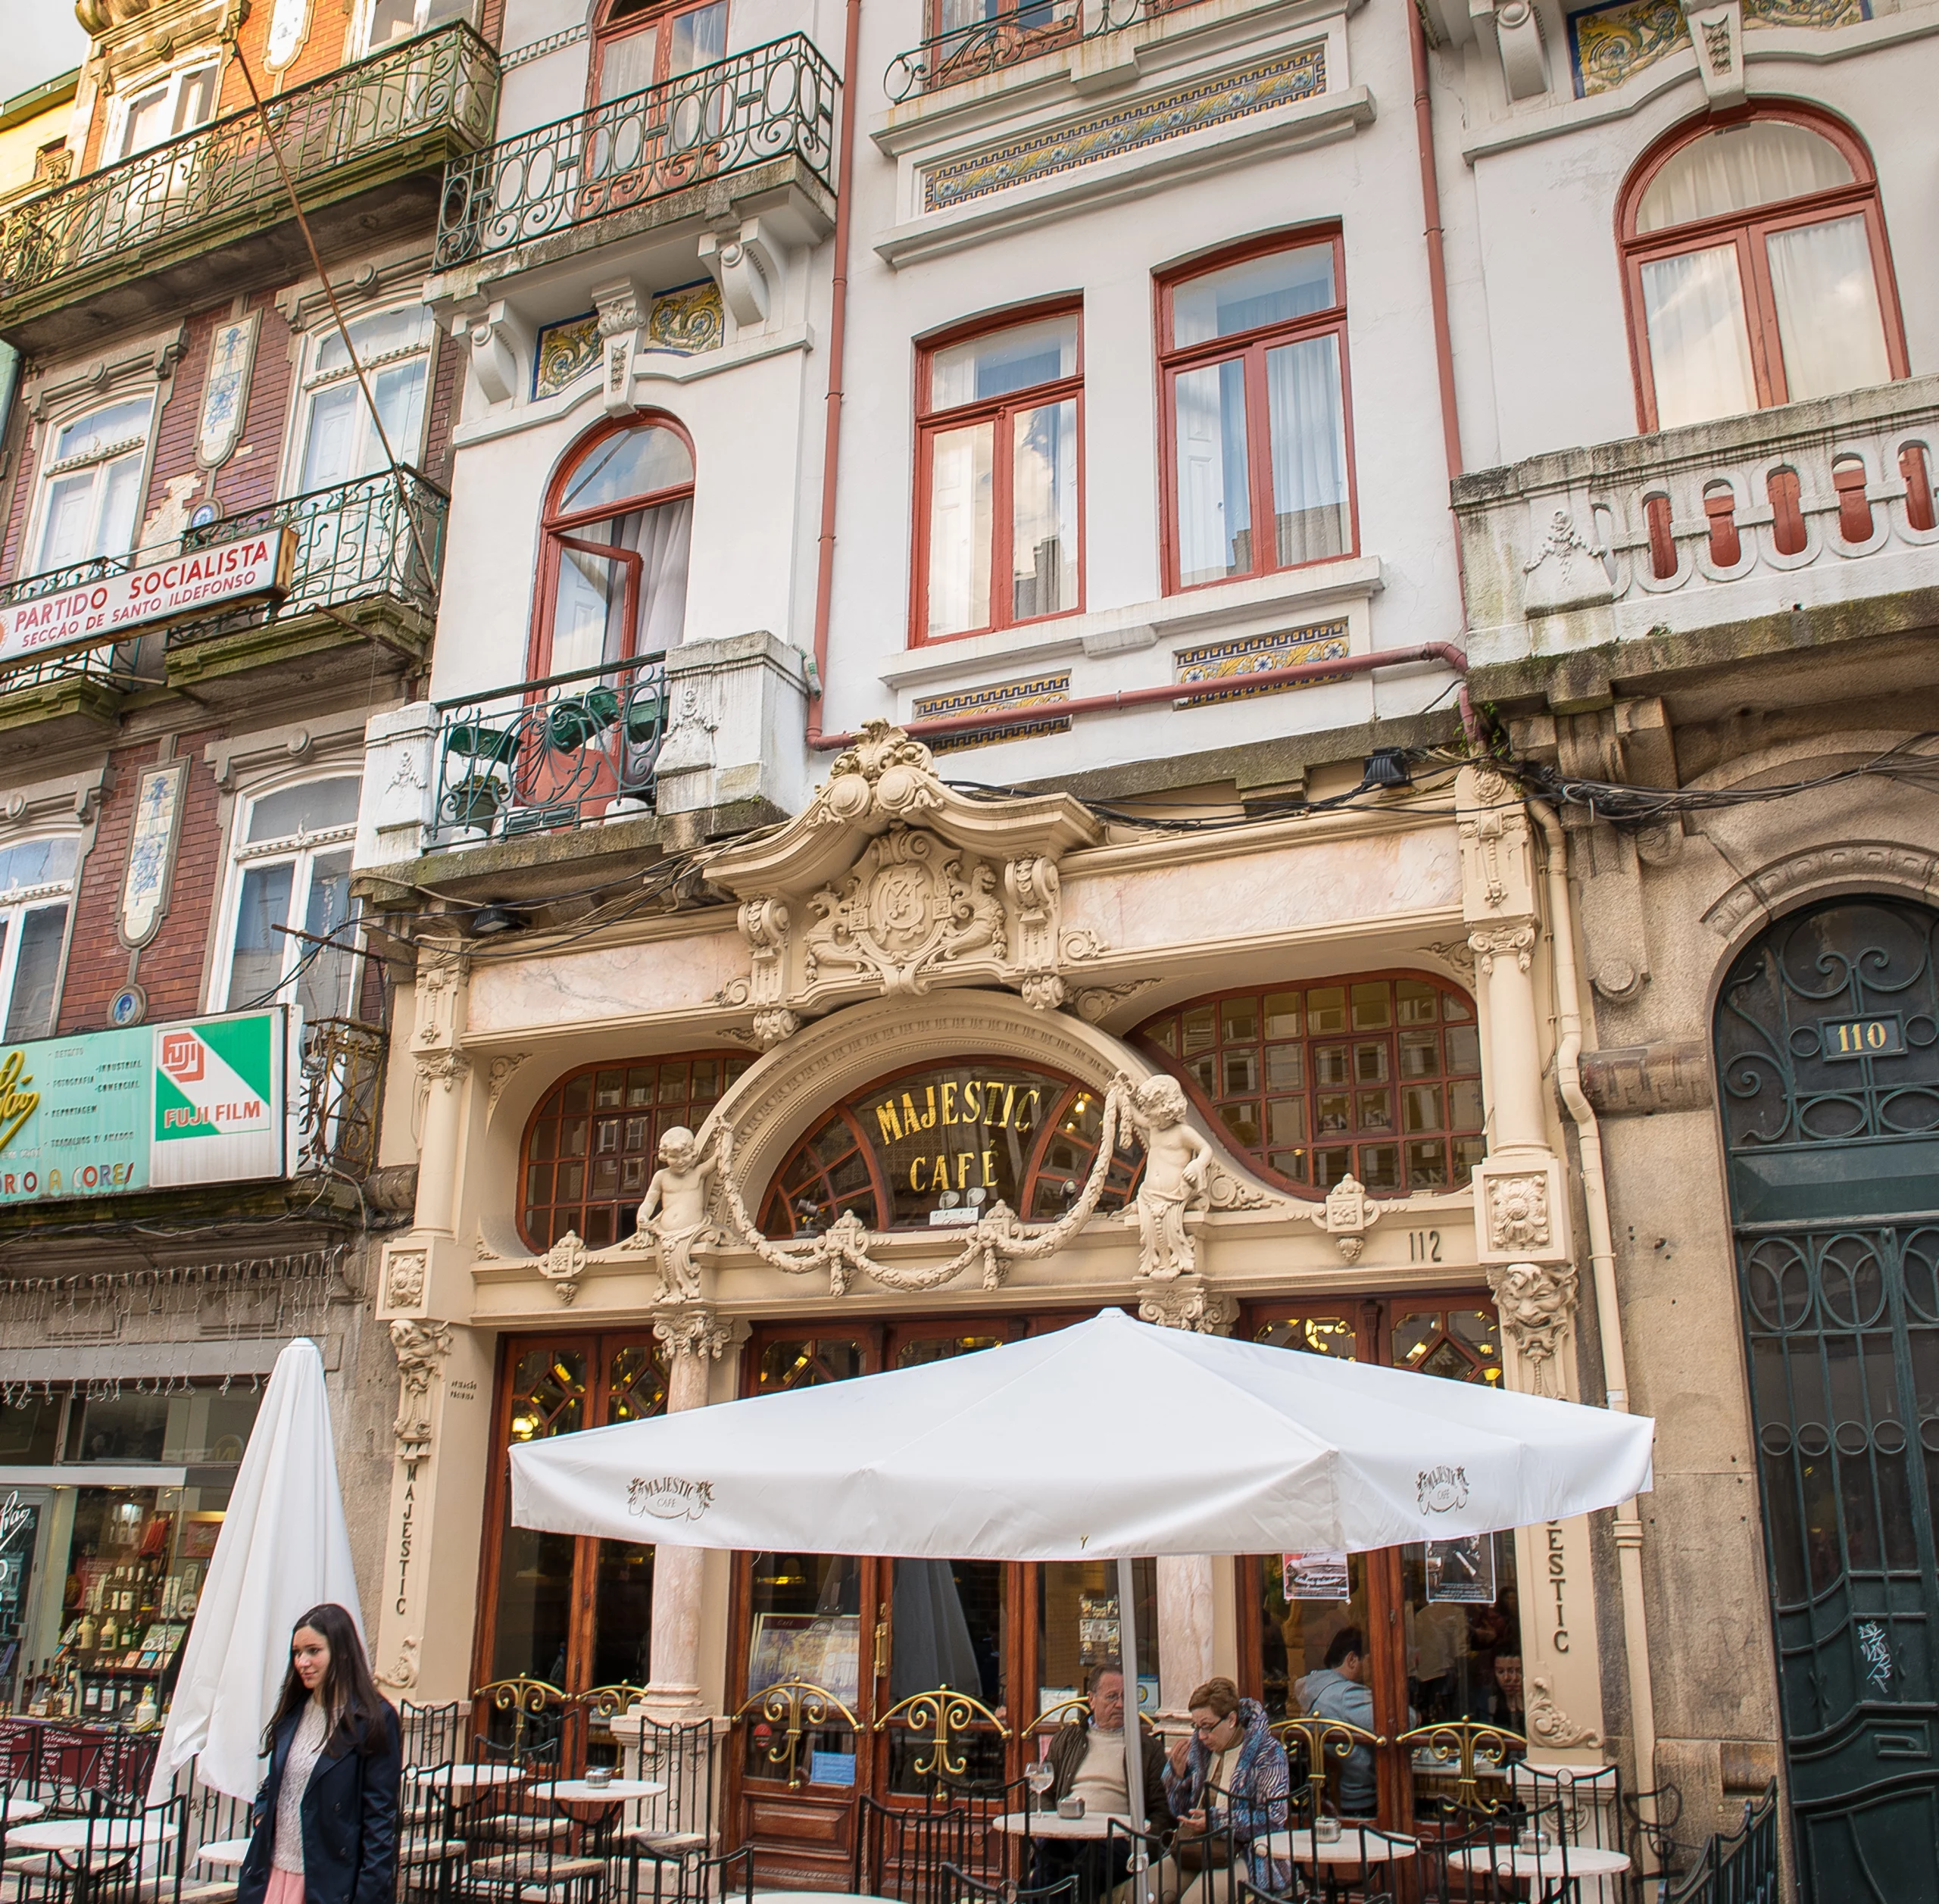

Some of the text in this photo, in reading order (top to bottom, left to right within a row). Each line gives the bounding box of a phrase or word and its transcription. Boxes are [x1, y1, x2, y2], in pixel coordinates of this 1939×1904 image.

[14, 541, 268, 633] PARTIDO SOCIALISTA
[86, 613, 105, 631] DE
[111, 597, 161, 623] SANTO
[168, 570, 256, 607] ILDEFONSO
[1838, 1022, 1887, 1052] 110
[164, 1100, 261, 1128] FUJI FILM
[875, 1080, 1041, 1146] MAJESTIC
[0, 1171, 38, 1195] RIO
[49, 1169, 61, 1191] A
[910, 1138, 1000, 1192] CAFÉ
[1409, 1230, 1442, 1263] 112
[644, 1476, 695, 1501] MAJESTIC
[396, 1463, 419, 1615] MAJESTIC
[1546, 1519, 1569, 1653] ESTIC
